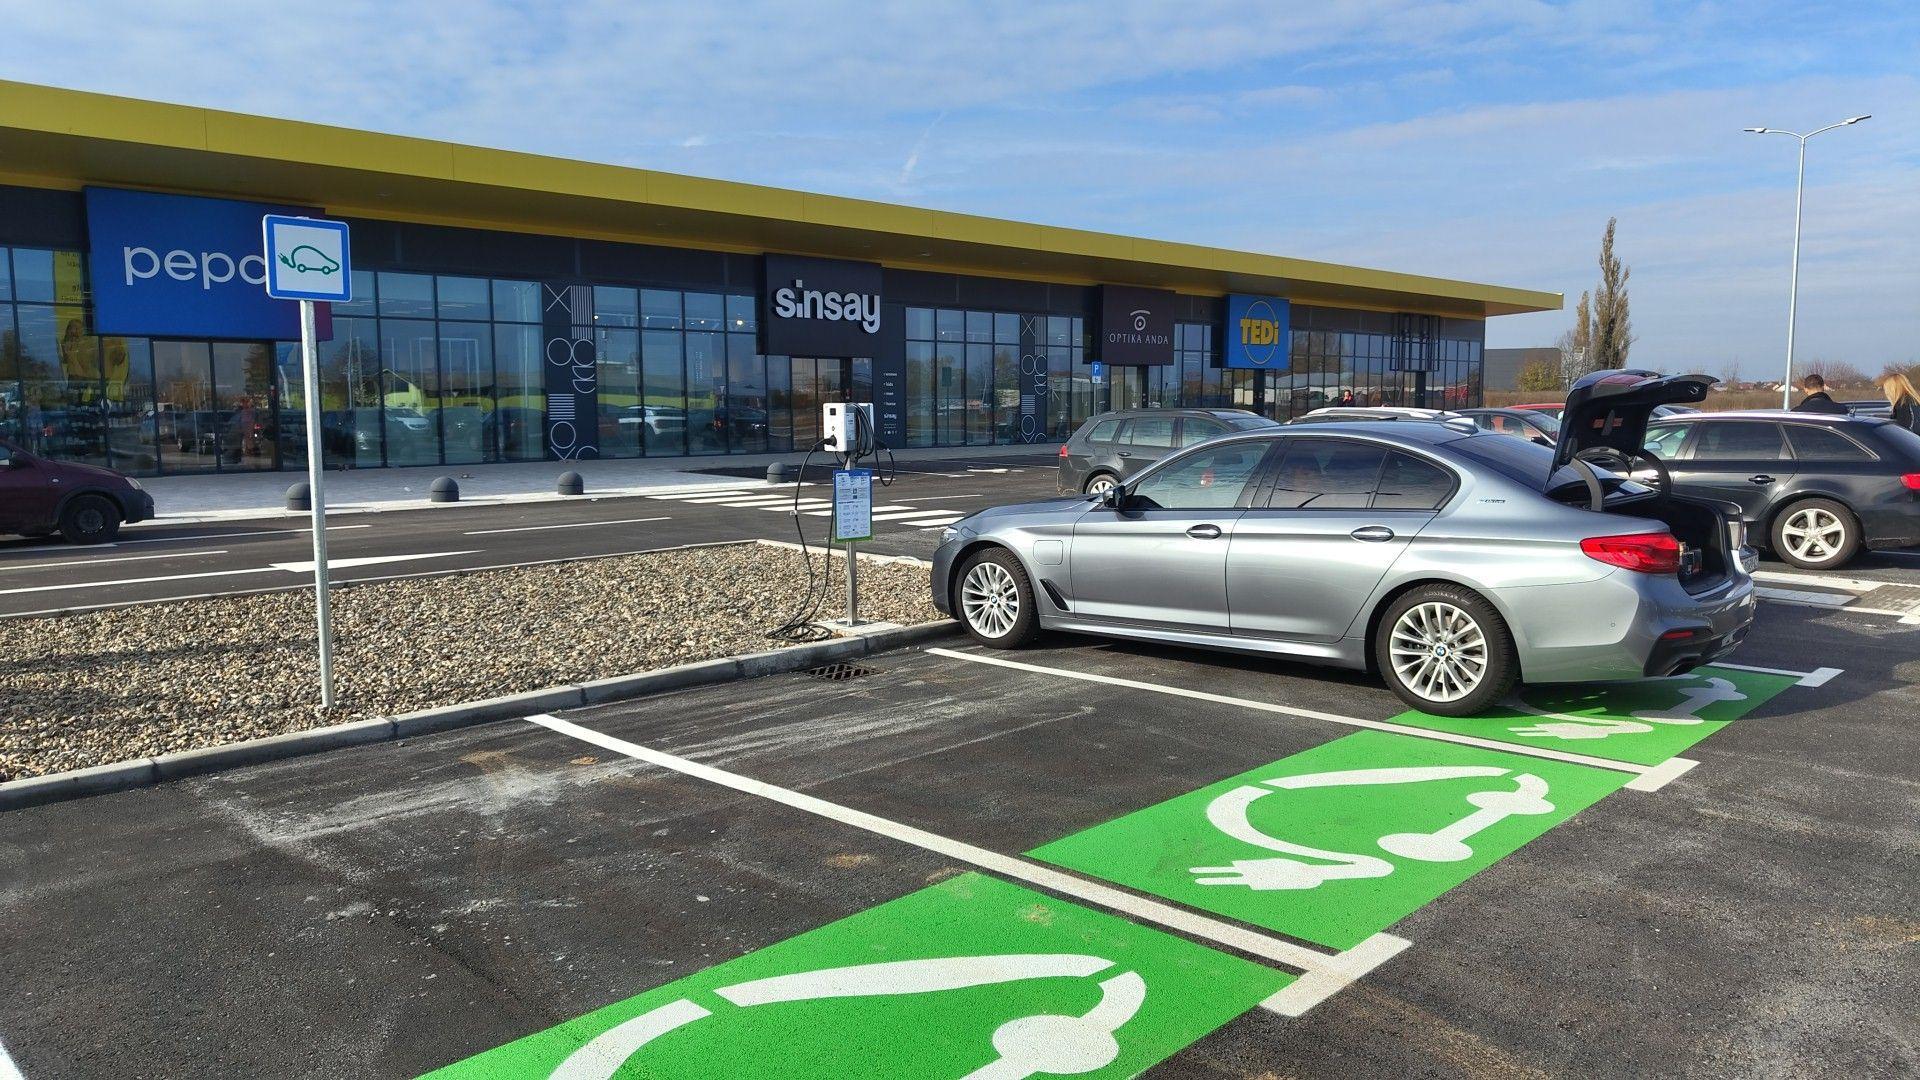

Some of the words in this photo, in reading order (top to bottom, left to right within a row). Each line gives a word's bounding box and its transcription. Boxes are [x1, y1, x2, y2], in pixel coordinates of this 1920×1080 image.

[123, 246, 266, 290] pepc
[775, 279, 881, 334] sinsay
[1109, 333, 1142, 344] OPTIKA
[1145, 335, 1169, 344] ANDA
[1240, 318, 1279, 345] TEDi
